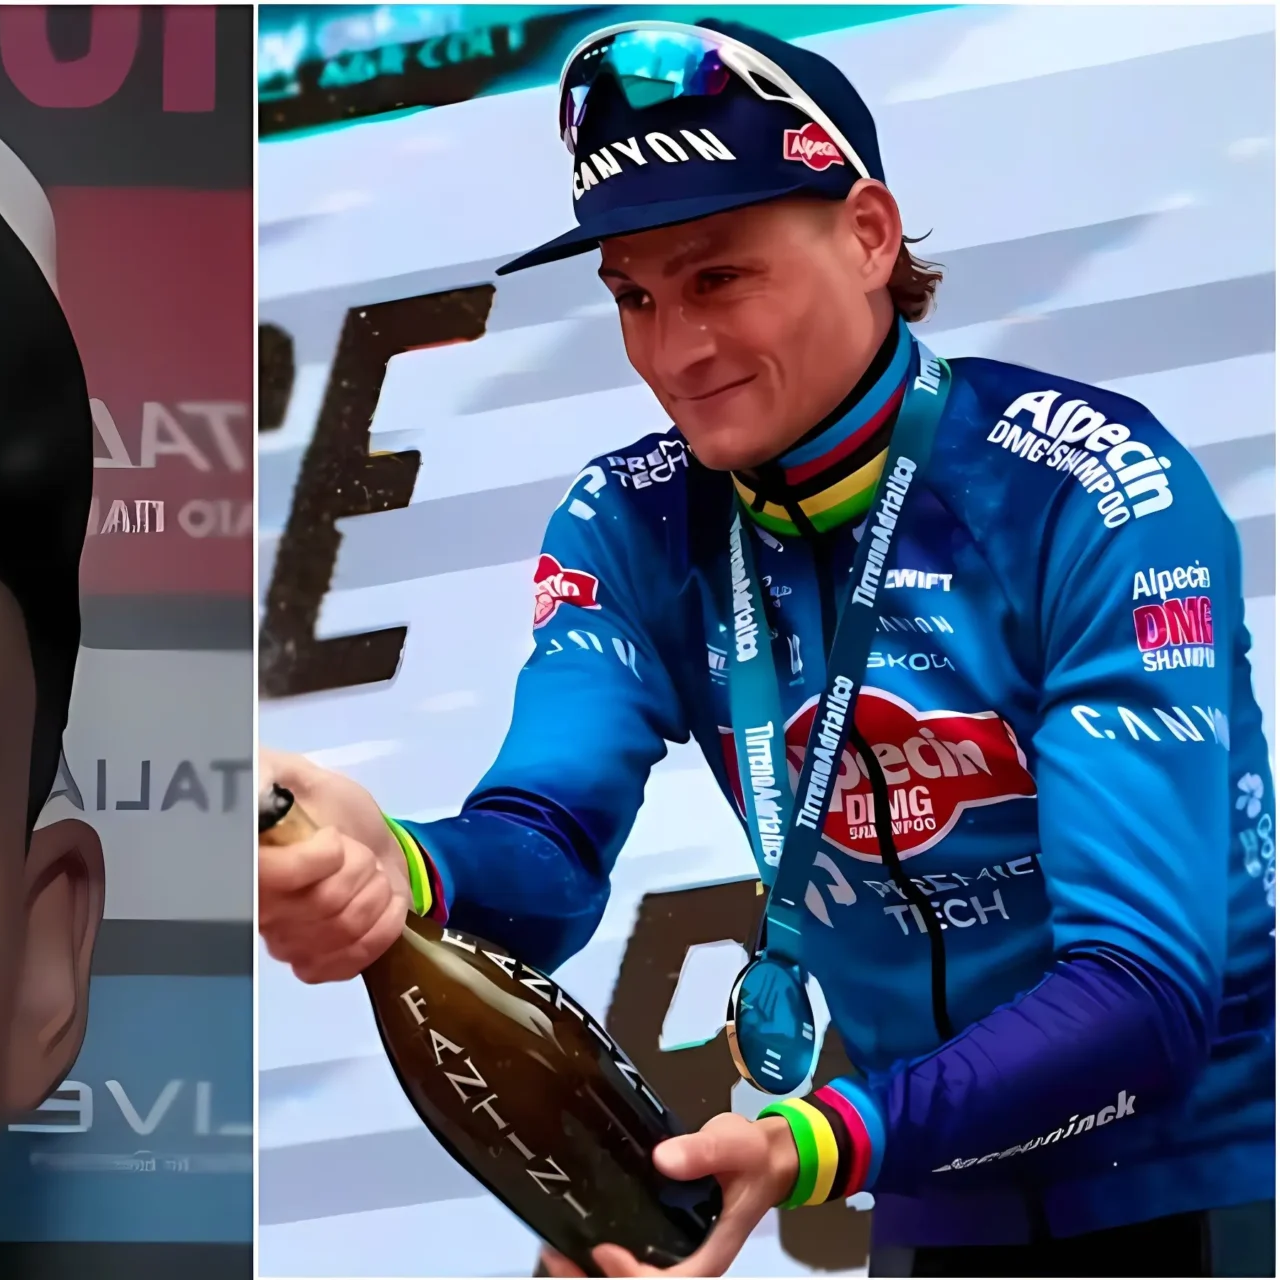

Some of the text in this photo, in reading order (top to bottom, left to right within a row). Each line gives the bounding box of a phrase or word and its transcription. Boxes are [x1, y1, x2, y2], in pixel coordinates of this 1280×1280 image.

[573, 126, 736, 199] CANYON
[986, 419, 1051, 463] DMG
[1003, 389, 1173, 519] Alpecin
[400, 984, 593, 1221] FANTINI
